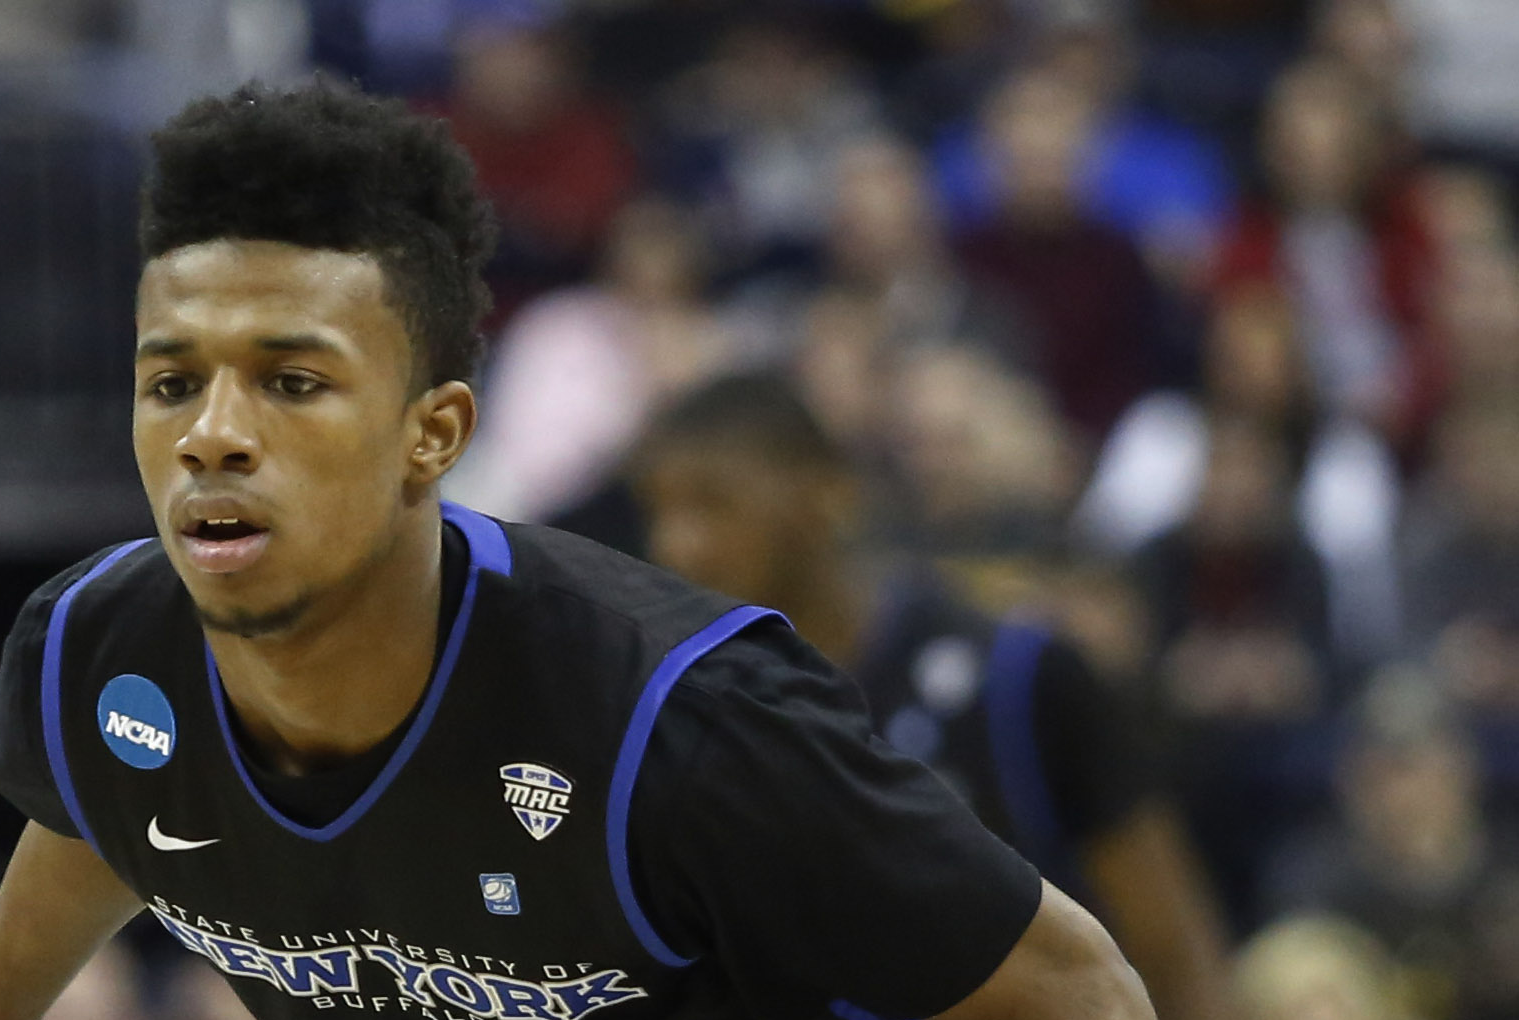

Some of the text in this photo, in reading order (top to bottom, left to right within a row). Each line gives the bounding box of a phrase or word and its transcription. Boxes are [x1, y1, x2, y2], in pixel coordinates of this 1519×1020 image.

[105, 710, 170, 757] NCAA
[503, 782, 571, 814] MAC
[146, 902, 362, 997] NEW
[153, 895, 594, 981] STATE UNIVERSITY OF
